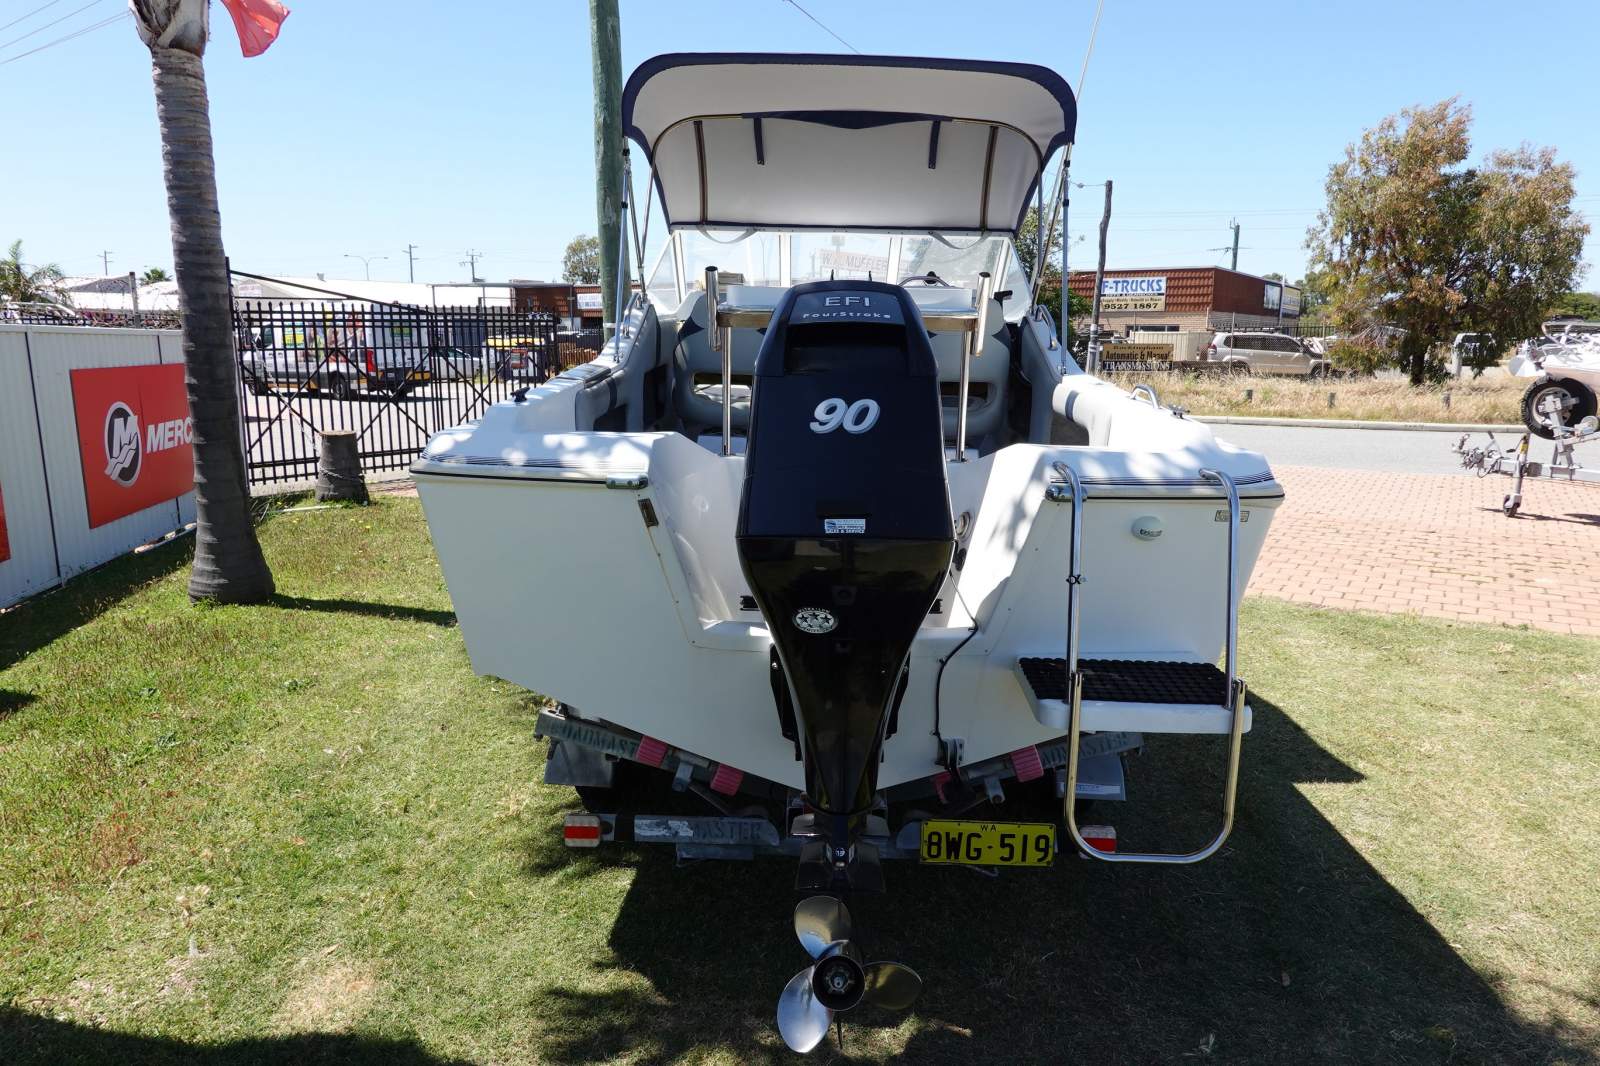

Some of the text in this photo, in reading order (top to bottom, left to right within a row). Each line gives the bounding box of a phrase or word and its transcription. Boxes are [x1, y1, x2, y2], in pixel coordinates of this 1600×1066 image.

[1102, 280, 1163, 293] F-TRUCKS
[825, 297, 870, 307] EFI
[809, 397, 880, 434] 90
[980, 824, 997, 832] WA
